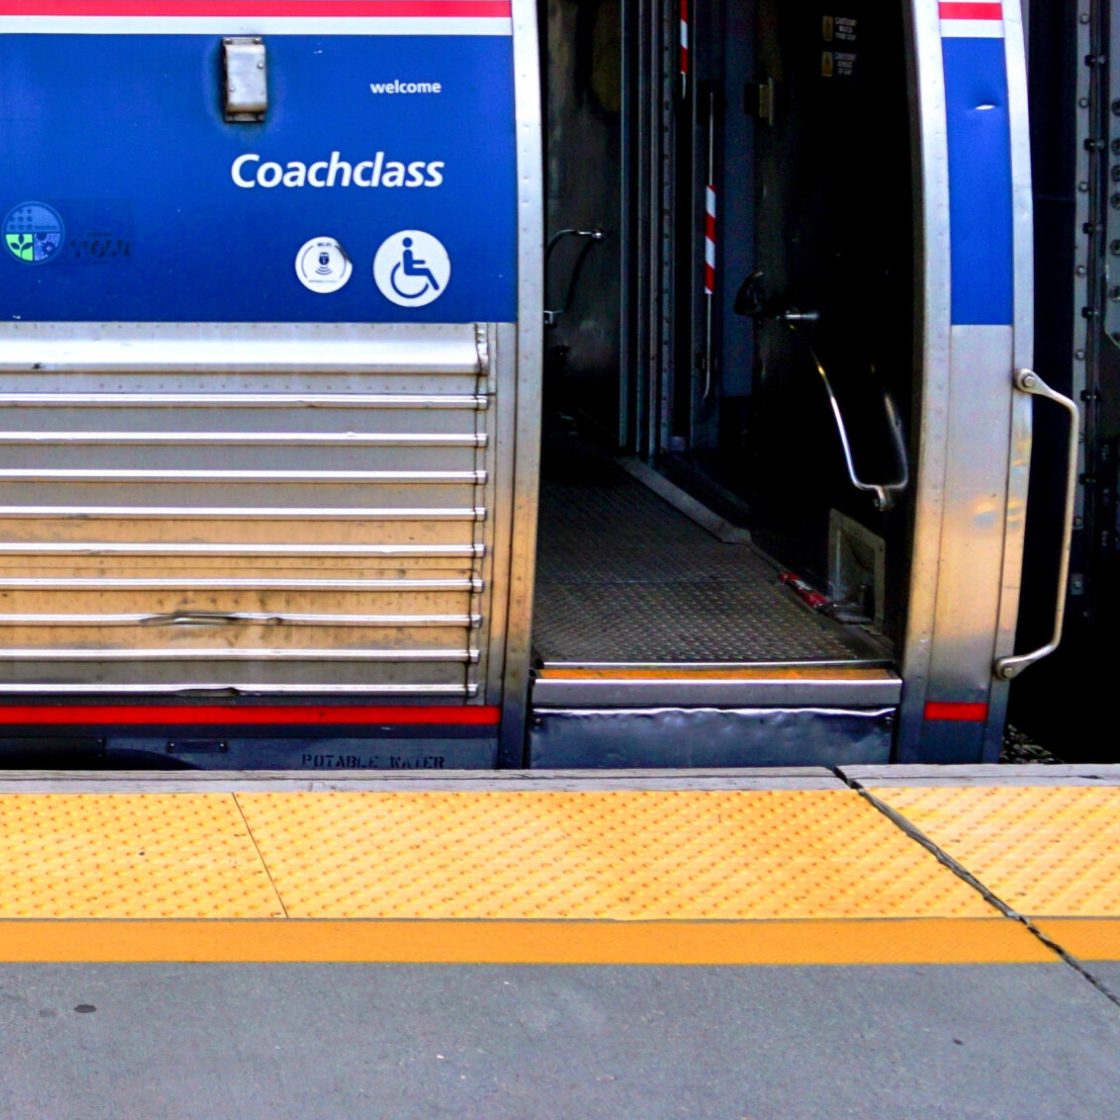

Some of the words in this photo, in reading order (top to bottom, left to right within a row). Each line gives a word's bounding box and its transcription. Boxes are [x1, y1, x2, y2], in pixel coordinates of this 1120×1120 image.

[370, 80, 442, 94] welcome
[231, 151, 445, 188] Coachclass
[301, 753, 378, 769] POTABLE
